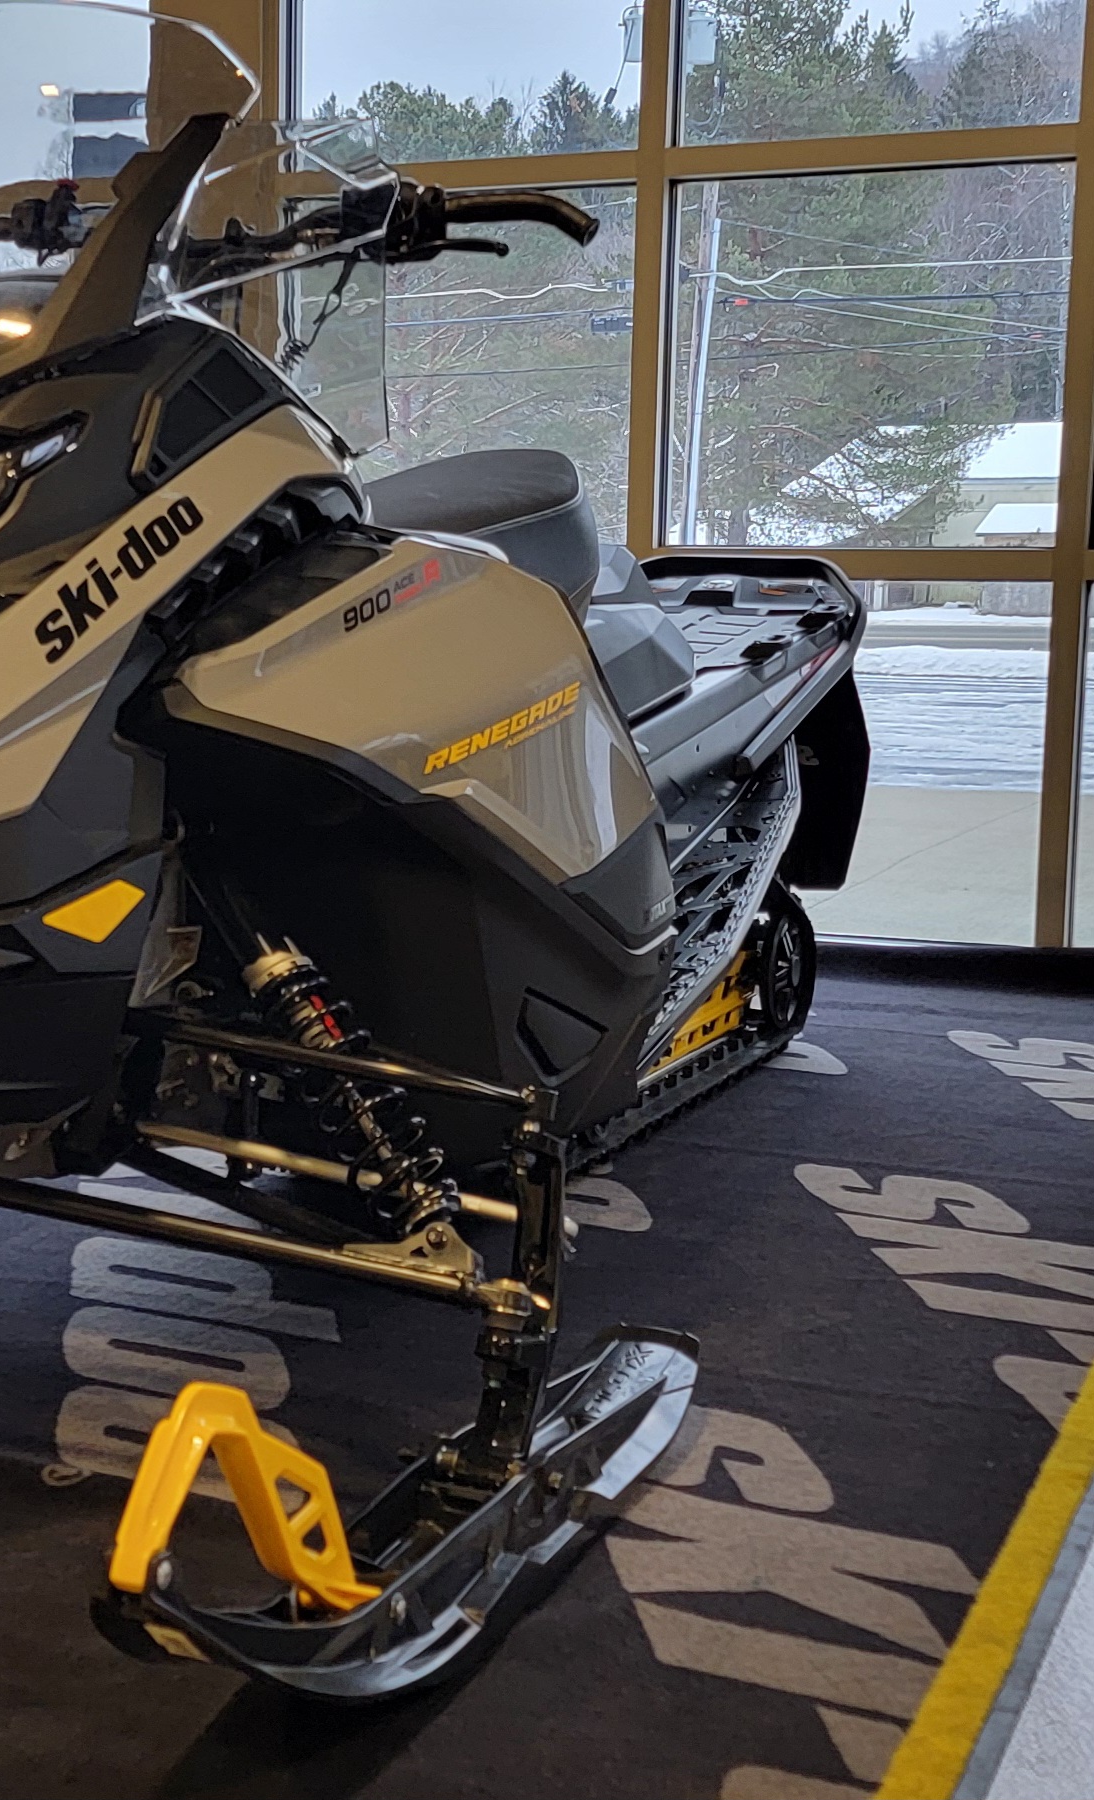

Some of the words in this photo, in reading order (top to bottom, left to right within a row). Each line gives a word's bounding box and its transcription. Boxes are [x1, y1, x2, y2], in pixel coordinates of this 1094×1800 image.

[35, 496, 204, 664] ski-doo
[343, 588, 391, 633] 900
[393, 572, 416, 594] ACE
[423, 681, 581, 775] RENEGADE
